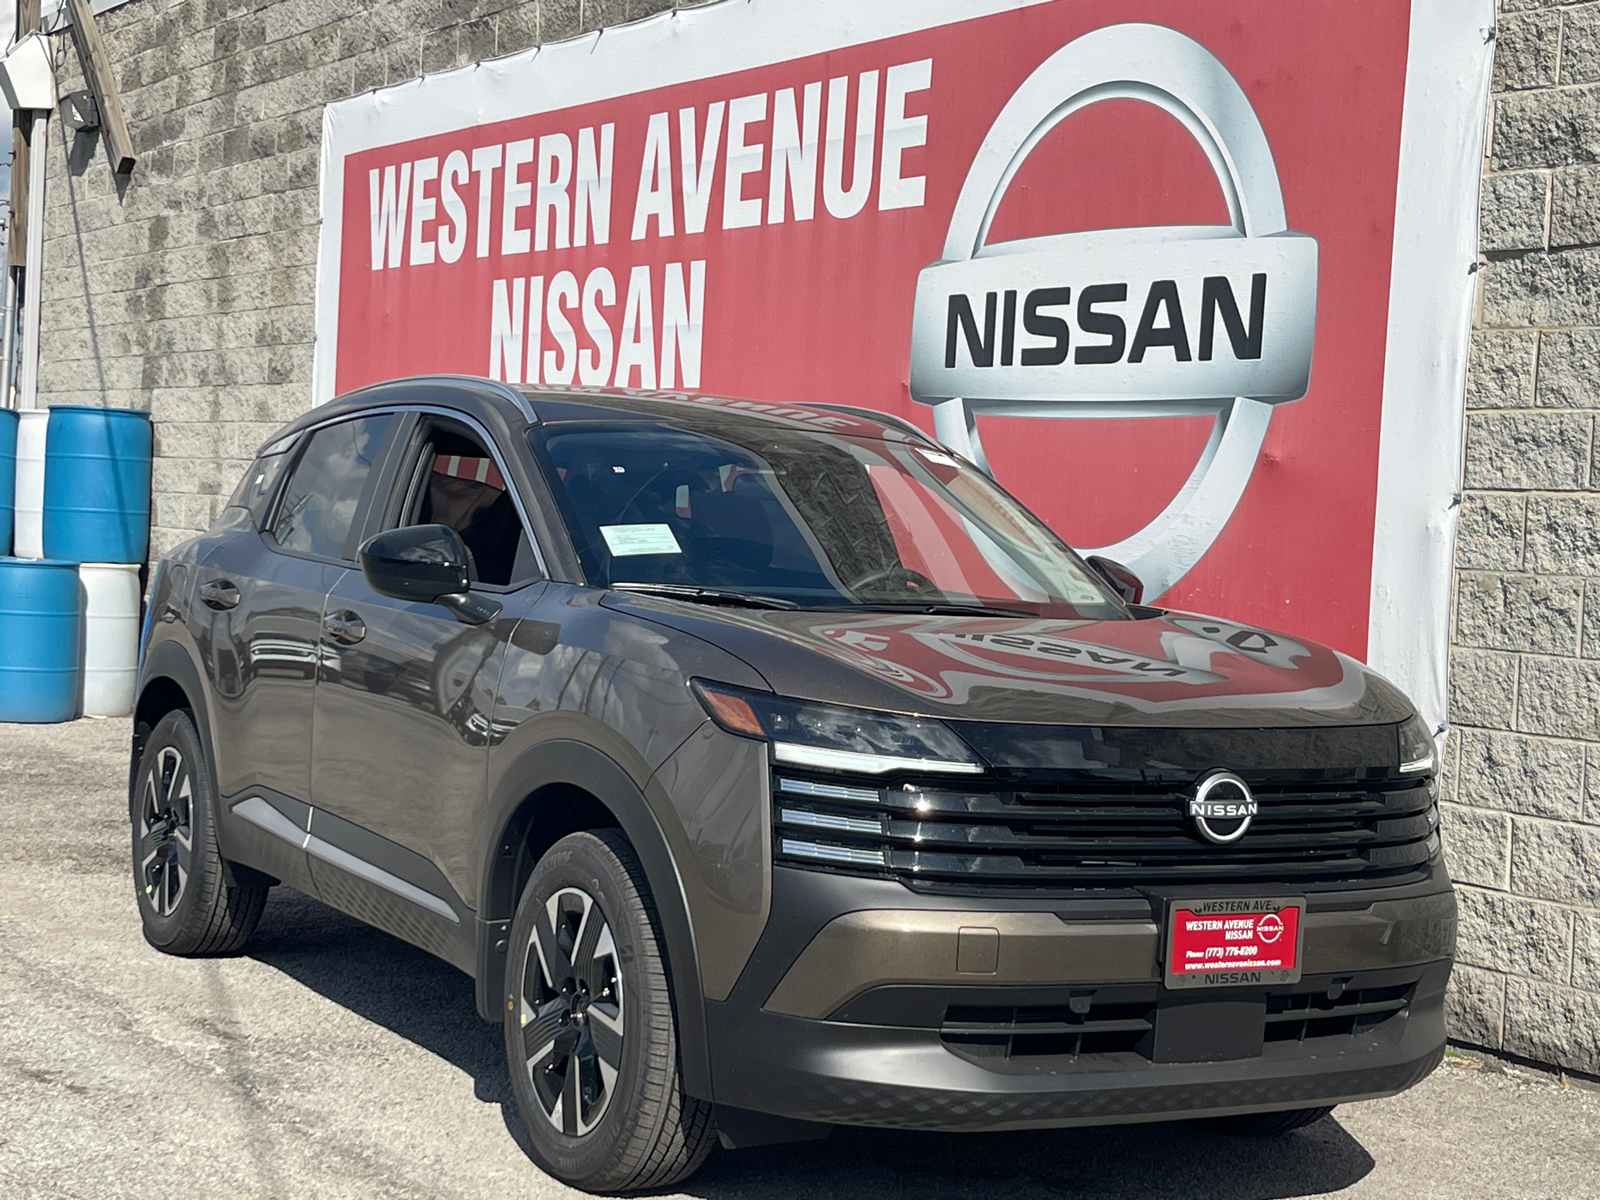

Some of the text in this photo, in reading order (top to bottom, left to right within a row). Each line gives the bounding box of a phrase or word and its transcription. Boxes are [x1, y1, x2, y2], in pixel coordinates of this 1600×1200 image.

[369, 58, 933, 271] WESTERN AVENUE
[489, 260, 707, 390] NISSAN
[945, 273, 1267, 369] NISSAN
[1191, 803, 1258, 816] NISSAN
[1202, 900, 1272, 912] WESTERN AVE
[1186, 919, 1254, 931] WESTERN AVENUE
[1225, 931, 1253, 940] NISSAN
[1205, 947, 1224, 959] (773)
[1205, 972, 1261, 984] NISSAN
